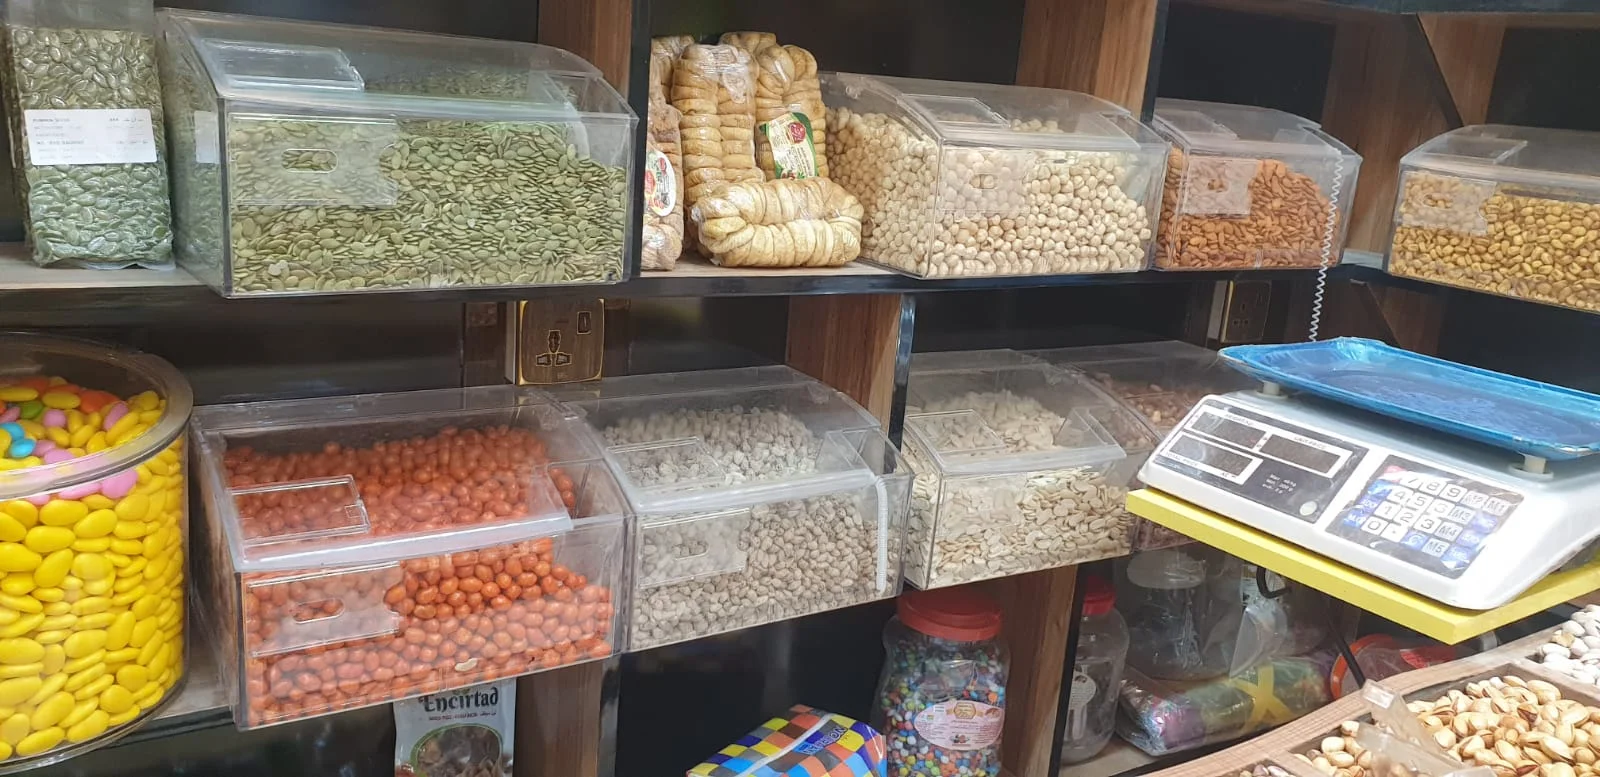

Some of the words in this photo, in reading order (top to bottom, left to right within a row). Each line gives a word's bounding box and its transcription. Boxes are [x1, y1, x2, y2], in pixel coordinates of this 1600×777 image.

[1426, 481, 1440, 491] 8
[1446, 487, 1461, 498] 9
[1394, 490, 1408, 500] 4
[1414, 496, 1427, 507] 5
[1449, 508, 1471, 521] M3
[1367, 520, 1381, 531] 0
[1426, 541, 1446, 553] M5
[1384, 505, 1394, 516] 1
[1401, 512, 1414, 523] 2
[1420, 518, 1435, 530] 3
[1440, 526, 1460, 539] M4
[418, 686, 499, 713] Encirtad
